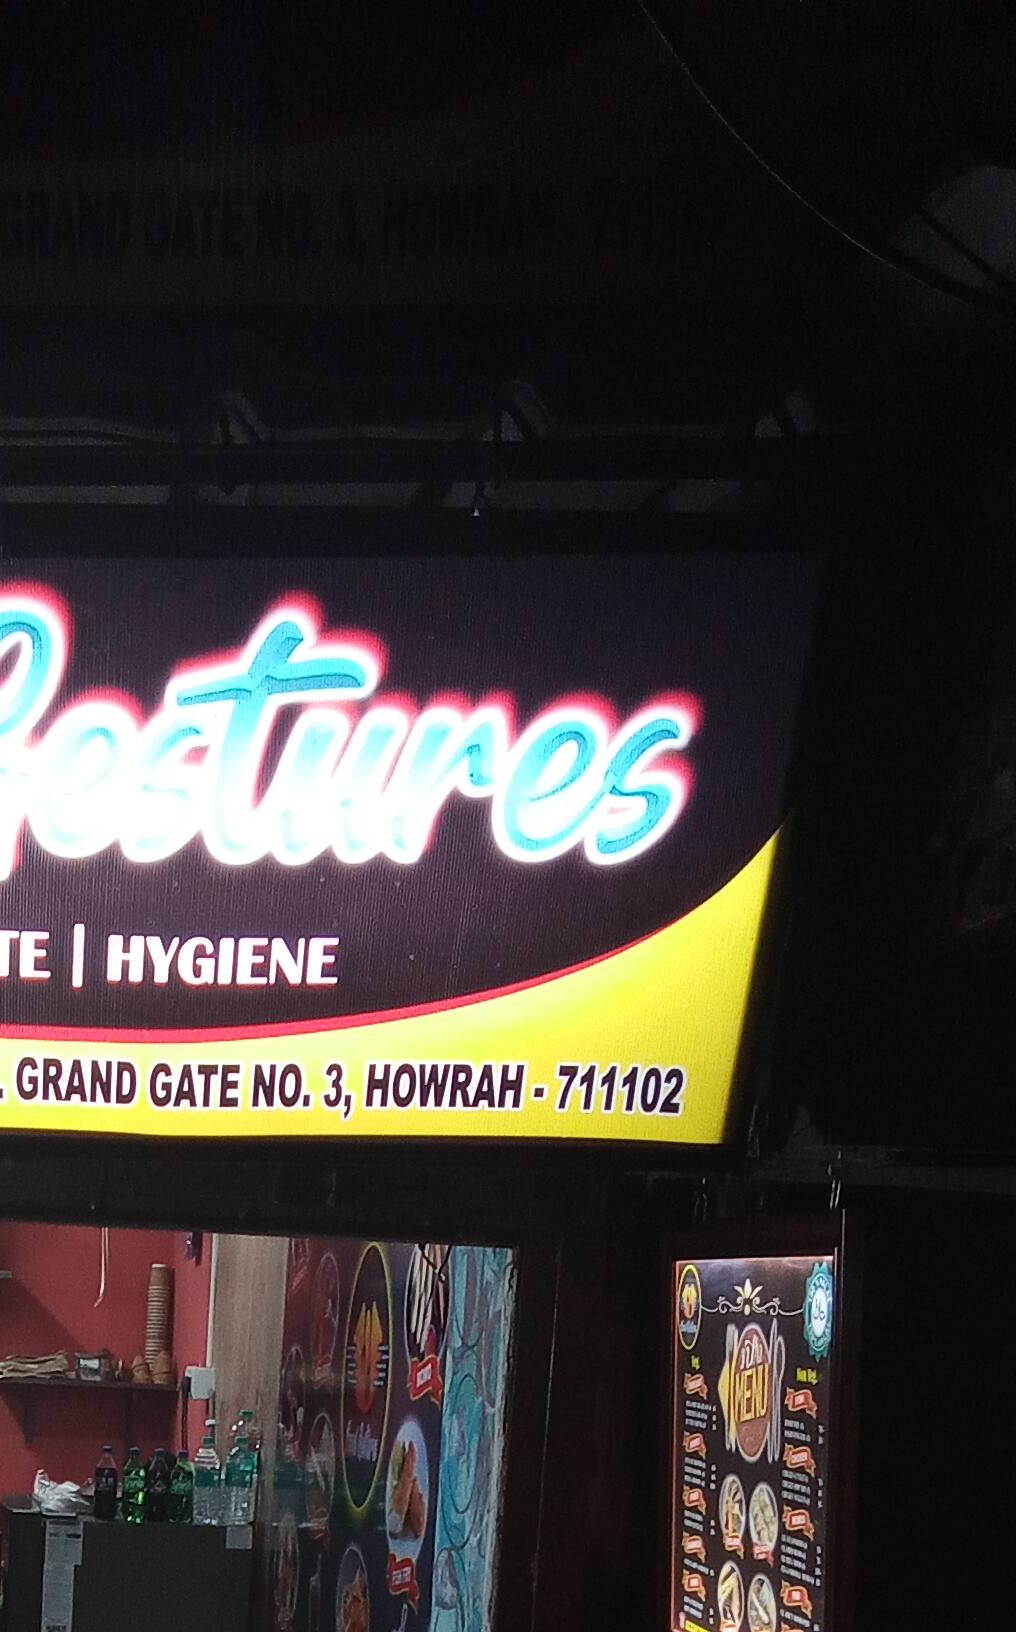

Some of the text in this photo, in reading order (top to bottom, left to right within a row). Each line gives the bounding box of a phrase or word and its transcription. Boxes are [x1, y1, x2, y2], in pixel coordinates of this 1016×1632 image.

[106, 934, 340, 986] HYGIENE
[16, 1056, 137, 1104] GRAND
[149, 1062, 241, 1108] GATE
[251, 1063, 311, 1108] NO.
[323, 1063, 352, 1118] 3,
[365, 1063, 525, 1109] HOWRAH
[558, 1065, 684, 1114] 711102
[734, 1362, 769, 1424] MENU
